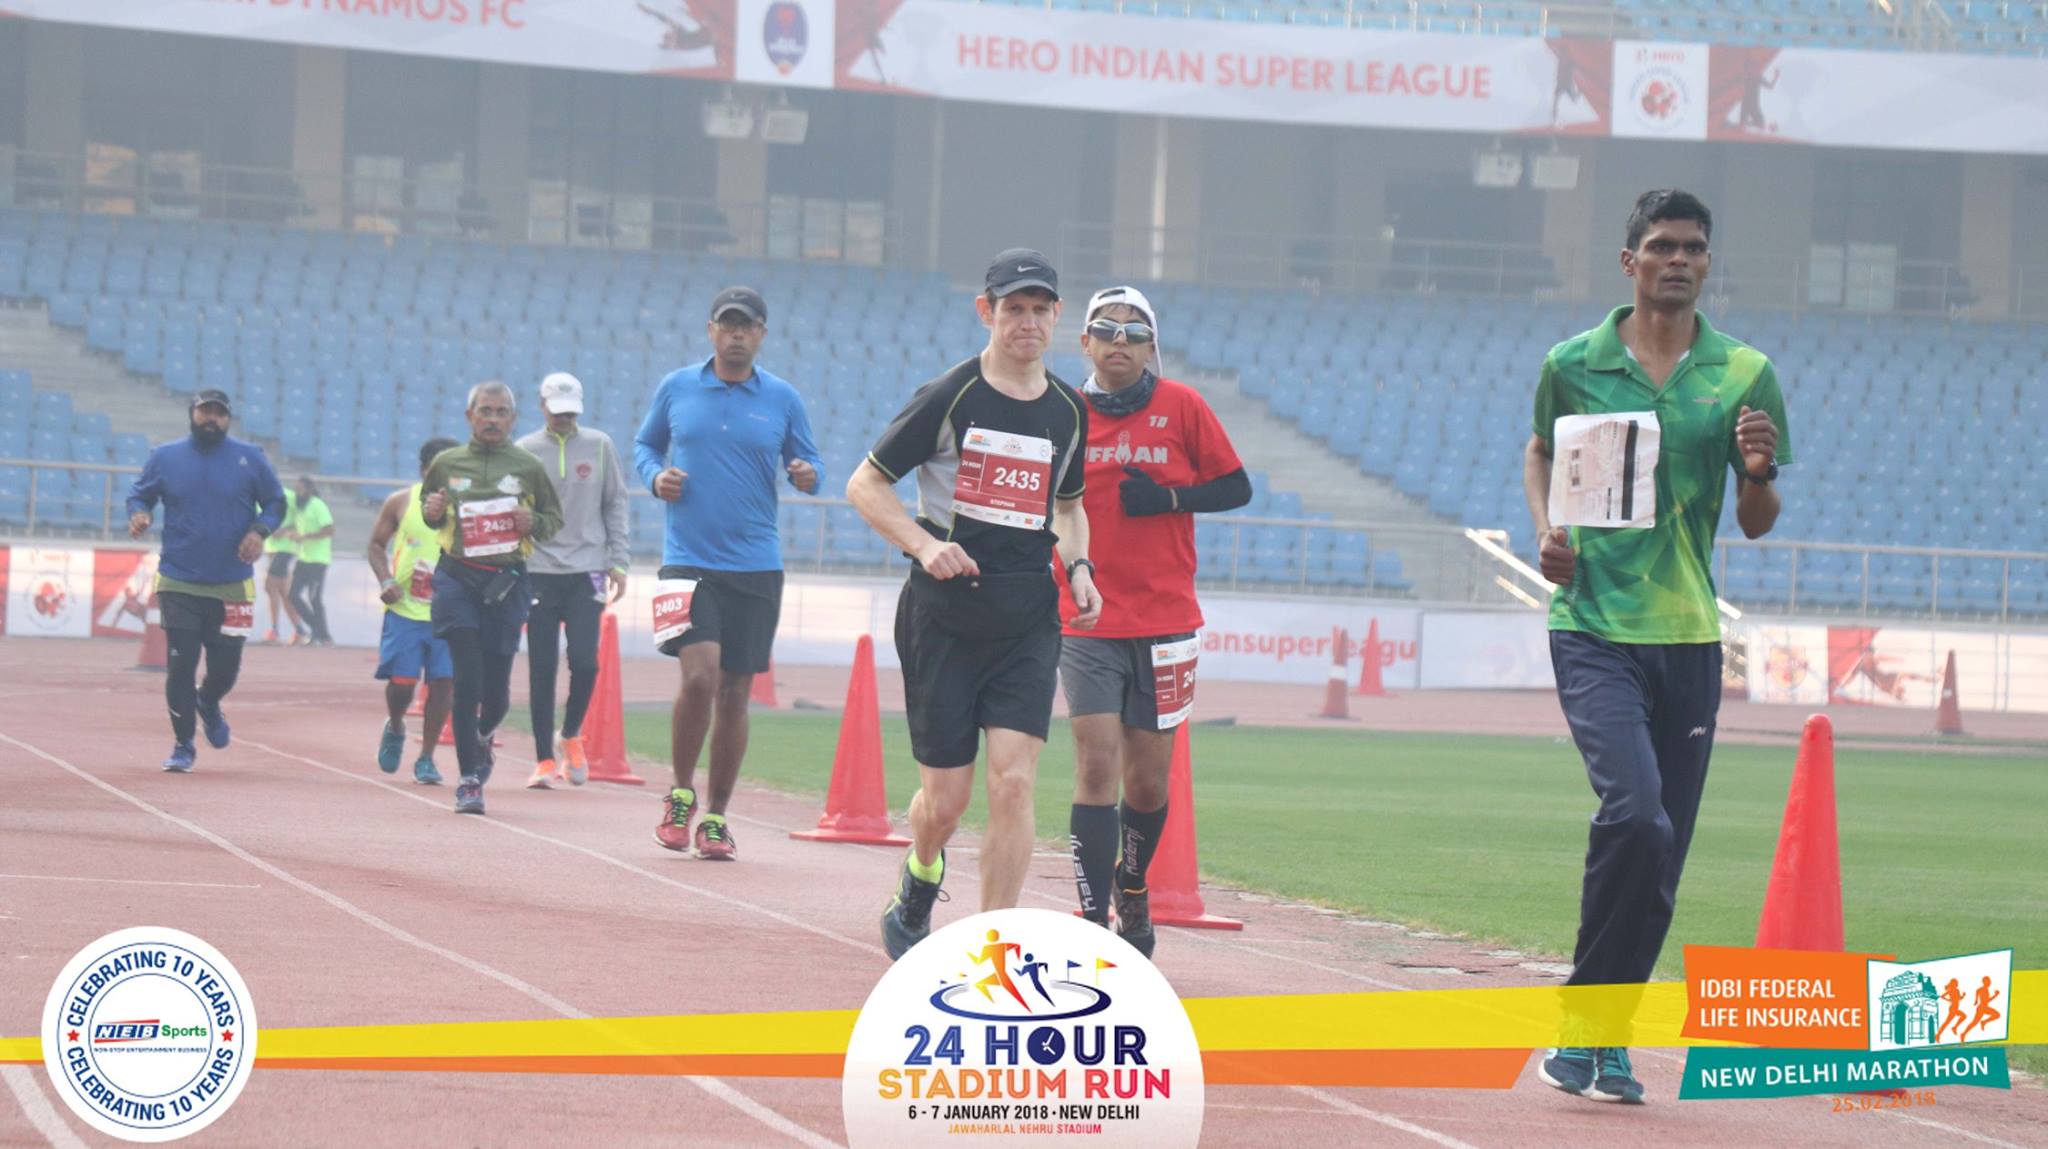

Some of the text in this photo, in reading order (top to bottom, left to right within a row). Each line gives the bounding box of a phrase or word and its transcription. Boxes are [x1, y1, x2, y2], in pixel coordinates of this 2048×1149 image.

[269, 0, 525, 29] AMOS FC
[957, 34, 1491, 99] HERO INDIAN SUPER LEAGUE
[993, 467, 1041, 491] 2435
[655, 597, 683, 617] 2403
[1200, 624, 1417, 667] ansuperlegu
